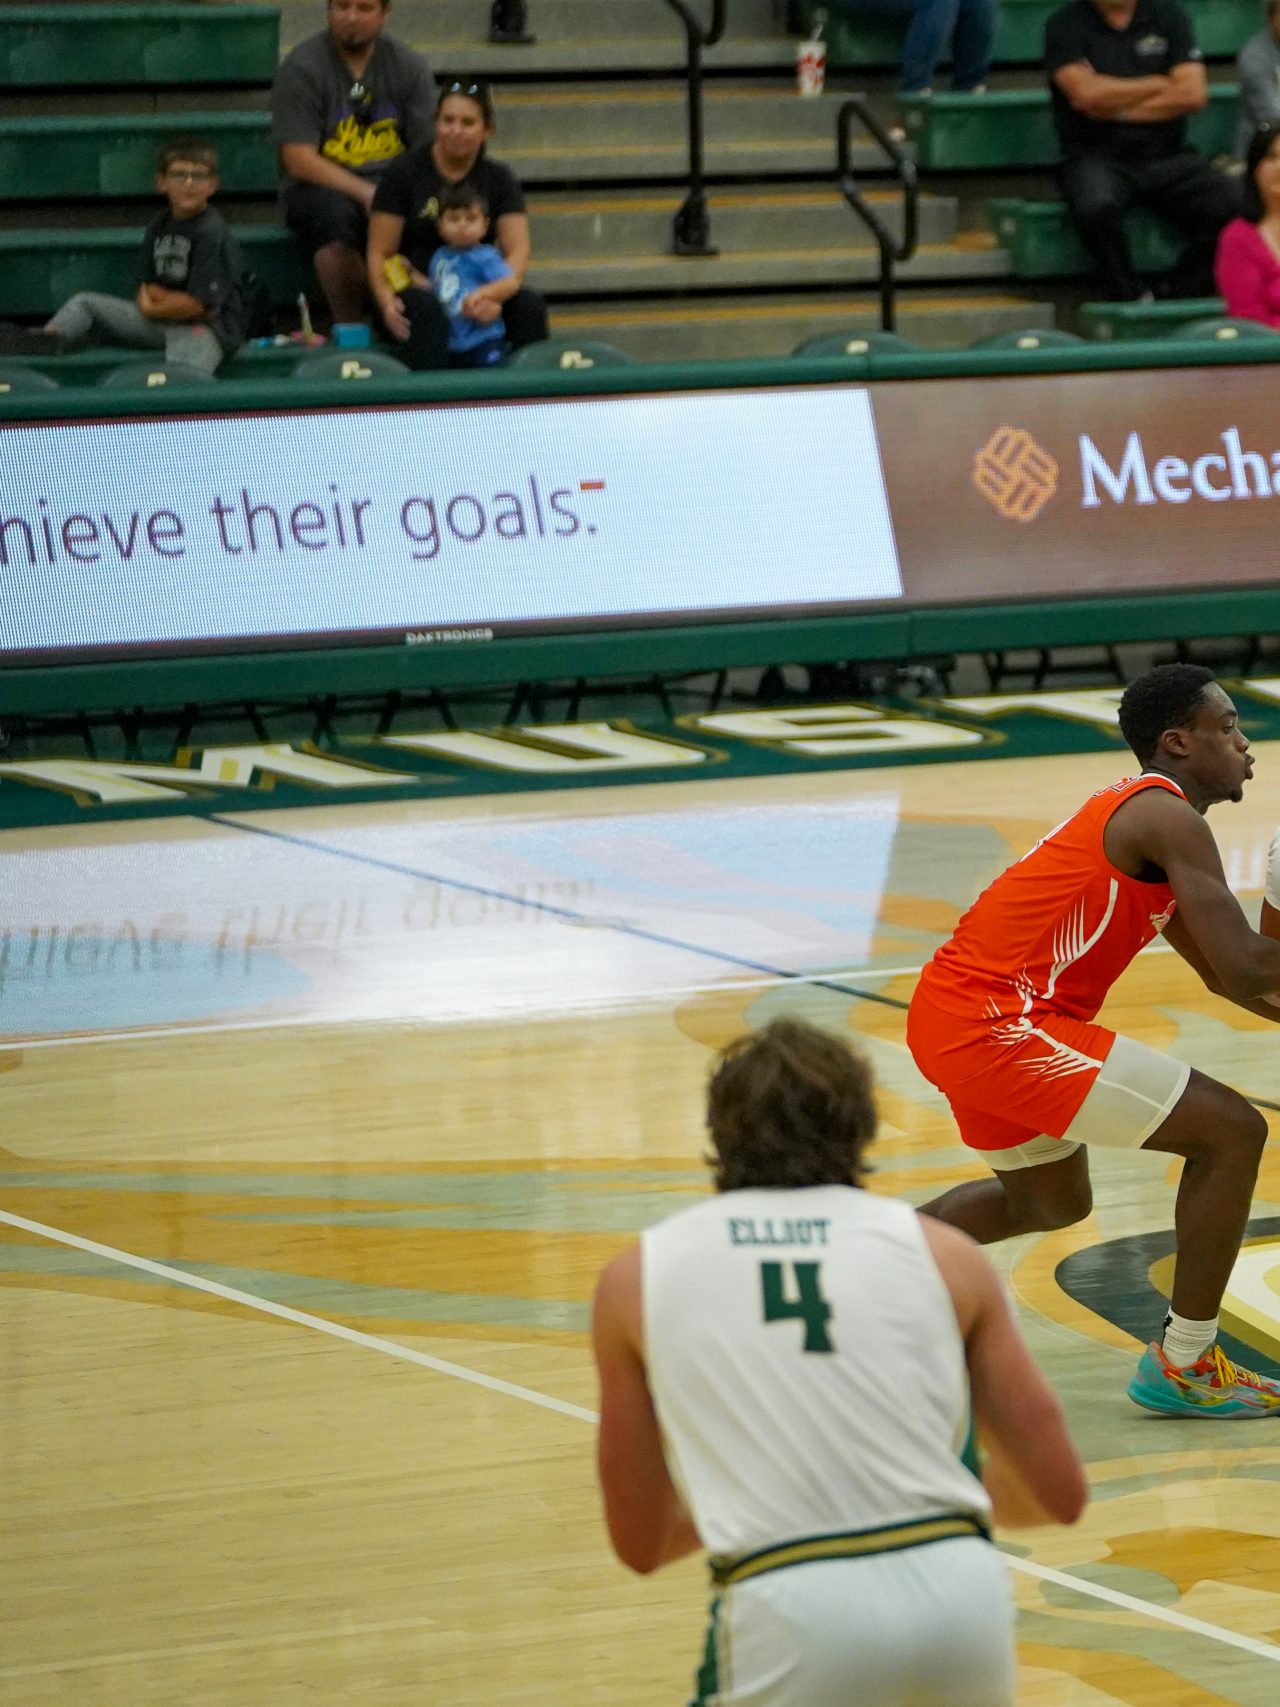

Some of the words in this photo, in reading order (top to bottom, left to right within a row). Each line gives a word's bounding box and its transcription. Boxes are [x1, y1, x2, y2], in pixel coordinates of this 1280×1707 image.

[212, 483, 373, 557] their
[400, 473, 599, 561] goals.
[729, 1217, 831, 1246] ELLIOT
[760, 1261, 838, 1353] 4
